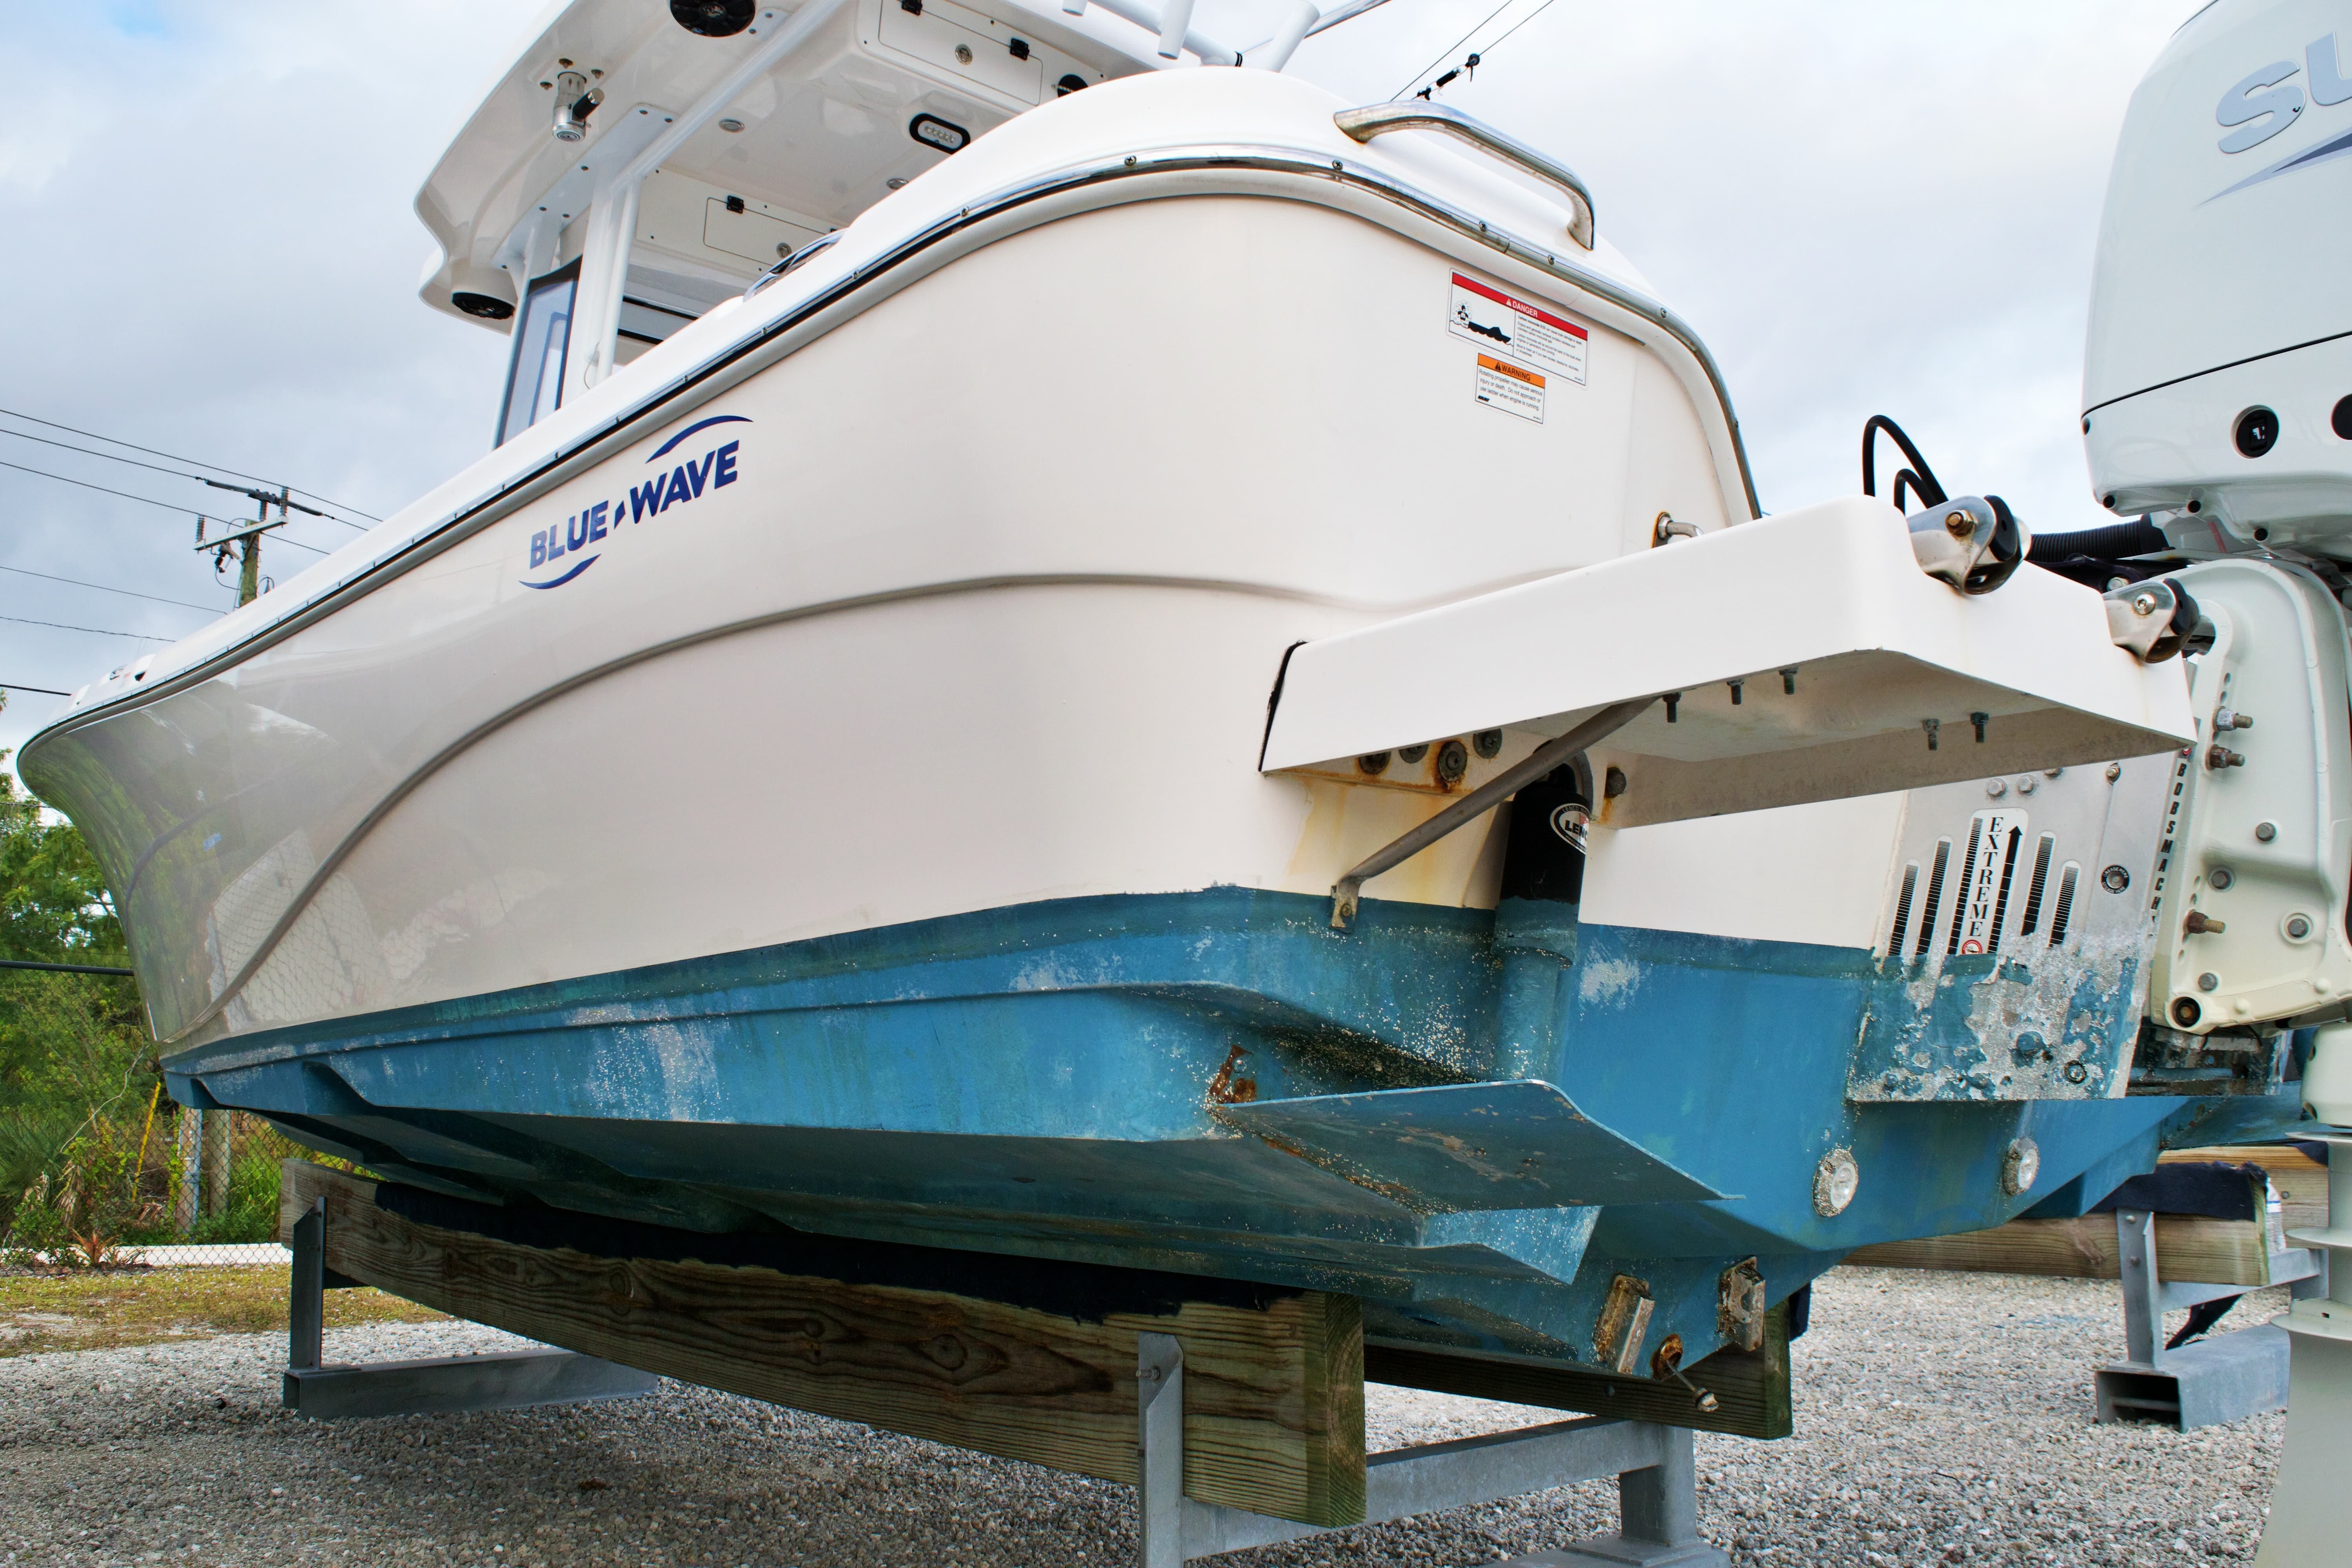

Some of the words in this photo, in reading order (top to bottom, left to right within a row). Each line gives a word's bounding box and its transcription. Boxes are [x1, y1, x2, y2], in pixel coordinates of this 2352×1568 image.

[1513, 301, 1537, 318] DANGER
[1502, 364, 1530, 381] WARNING
[530, 500, 609, 570] BLUE
[630, 439, 739, 524] WAVE
[1967, 817, 2004, 936] EXTREME
